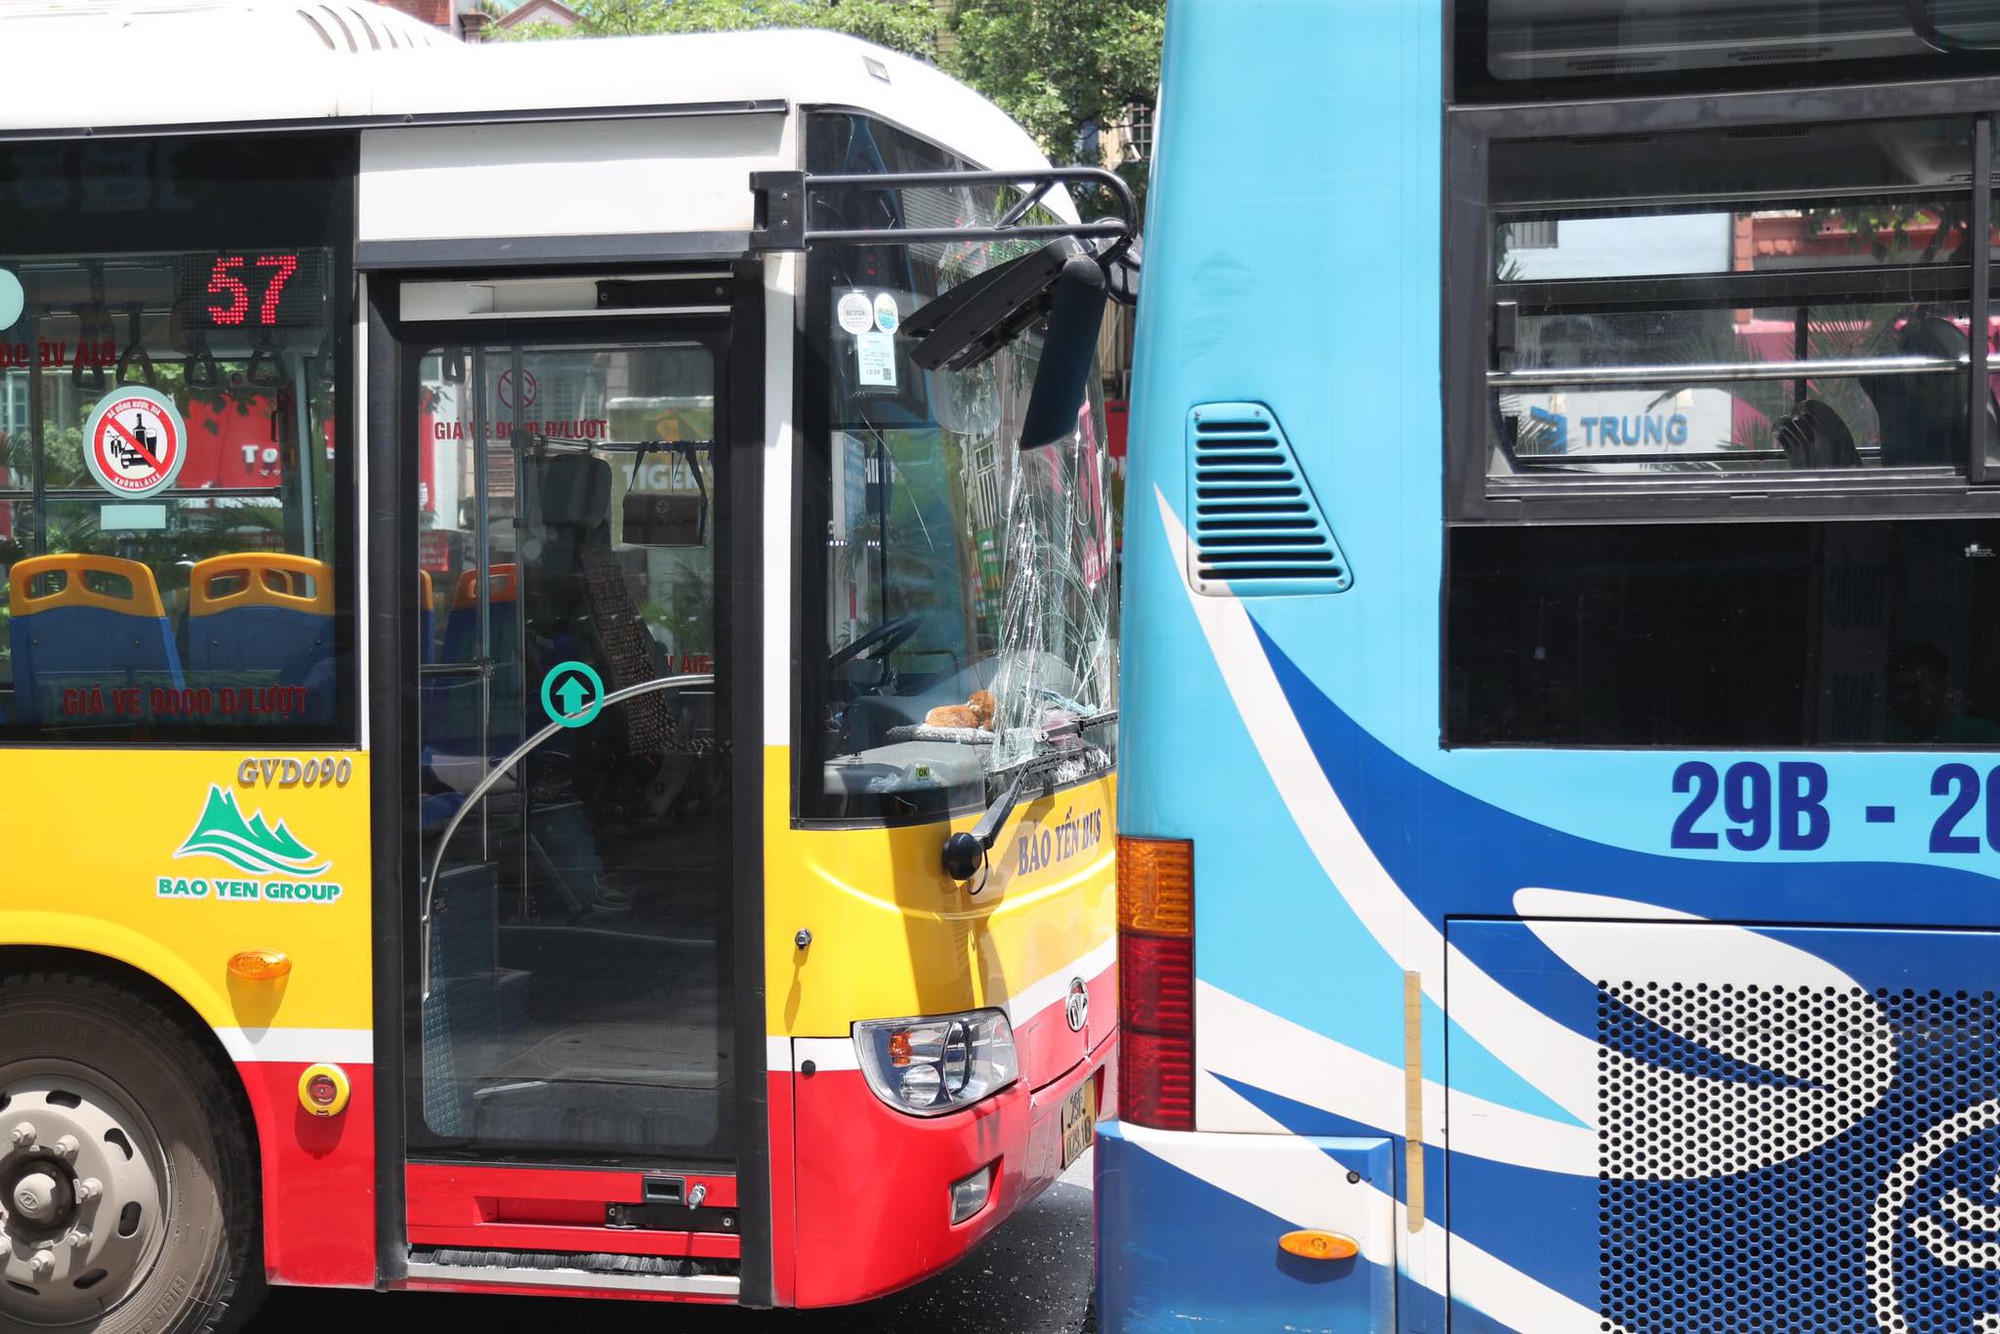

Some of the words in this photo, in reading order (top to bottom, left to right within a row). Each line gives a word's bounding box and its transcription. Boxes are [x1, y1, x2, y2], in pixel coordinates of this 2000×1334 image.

[207, 255, 298, 325] 57
[434, 416, 464, 440] GIÁ
[1579, 413, 1689, 448] TRUNG
[63, 683, 106, 716] GIÁ
[151, 687, 212, 716] 9000
[237, 757, 352, 787] GVD090
[1669, 760, 1831, 852] 29B
[1082, 808, 1102, 851] BUS
[158, 878, 208, 896] BAO
[214, 880, 259, 898] YEN
[264, 882, 341, 900] GROUP
